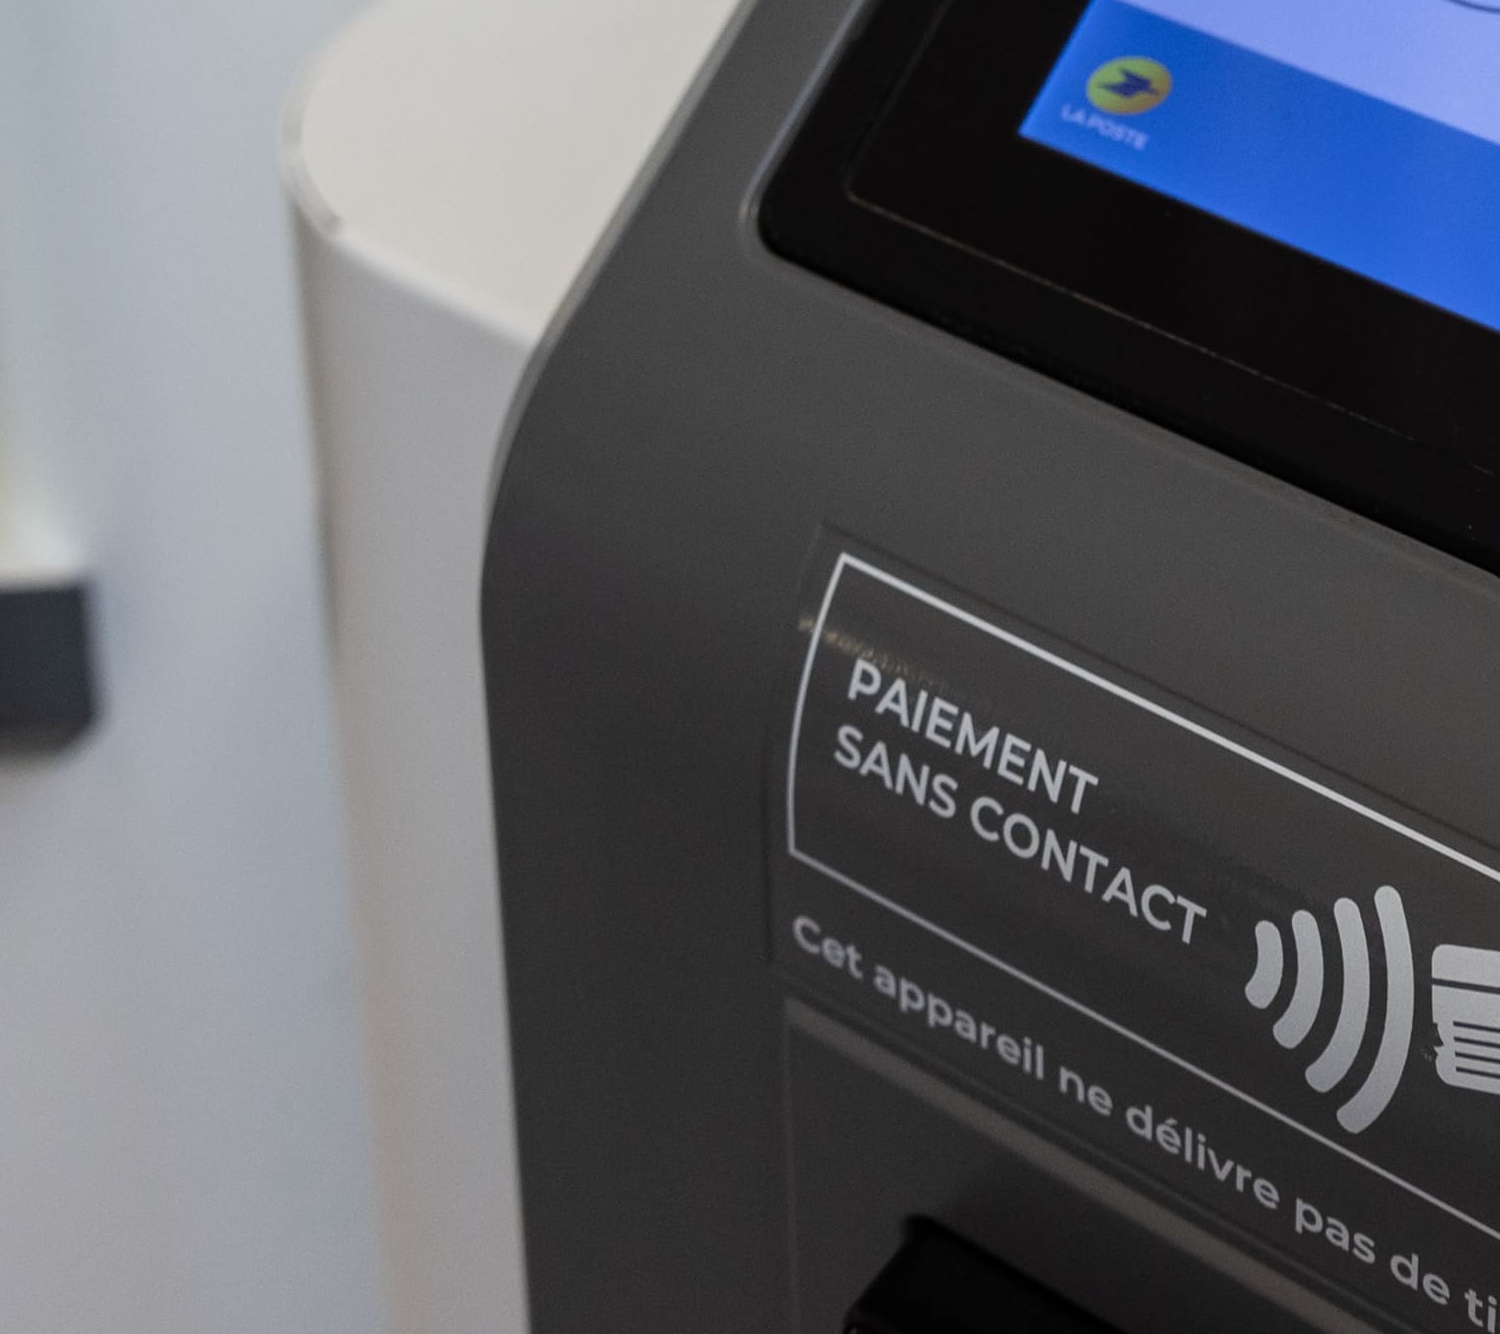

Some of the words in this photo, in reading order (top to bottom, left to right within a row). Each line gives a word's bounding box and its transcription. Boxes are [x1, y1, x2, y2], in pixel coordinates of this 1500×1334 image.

[833, 724, 959, 819] SANS
[969, 795, 1208, 945] CONTACT
[846, 657, 1100, 815] PAIEMENT
[792, 915, 863, 980] Cet
[872, 963, 1045, 1081] appareil
[1059, 1065, 1114, 1117] ne
[1126, 1104, 1280, 1210] délivre
[1294, 1197, 1376, 1264] pas
[1389, 1252, 1450, 1306] de
